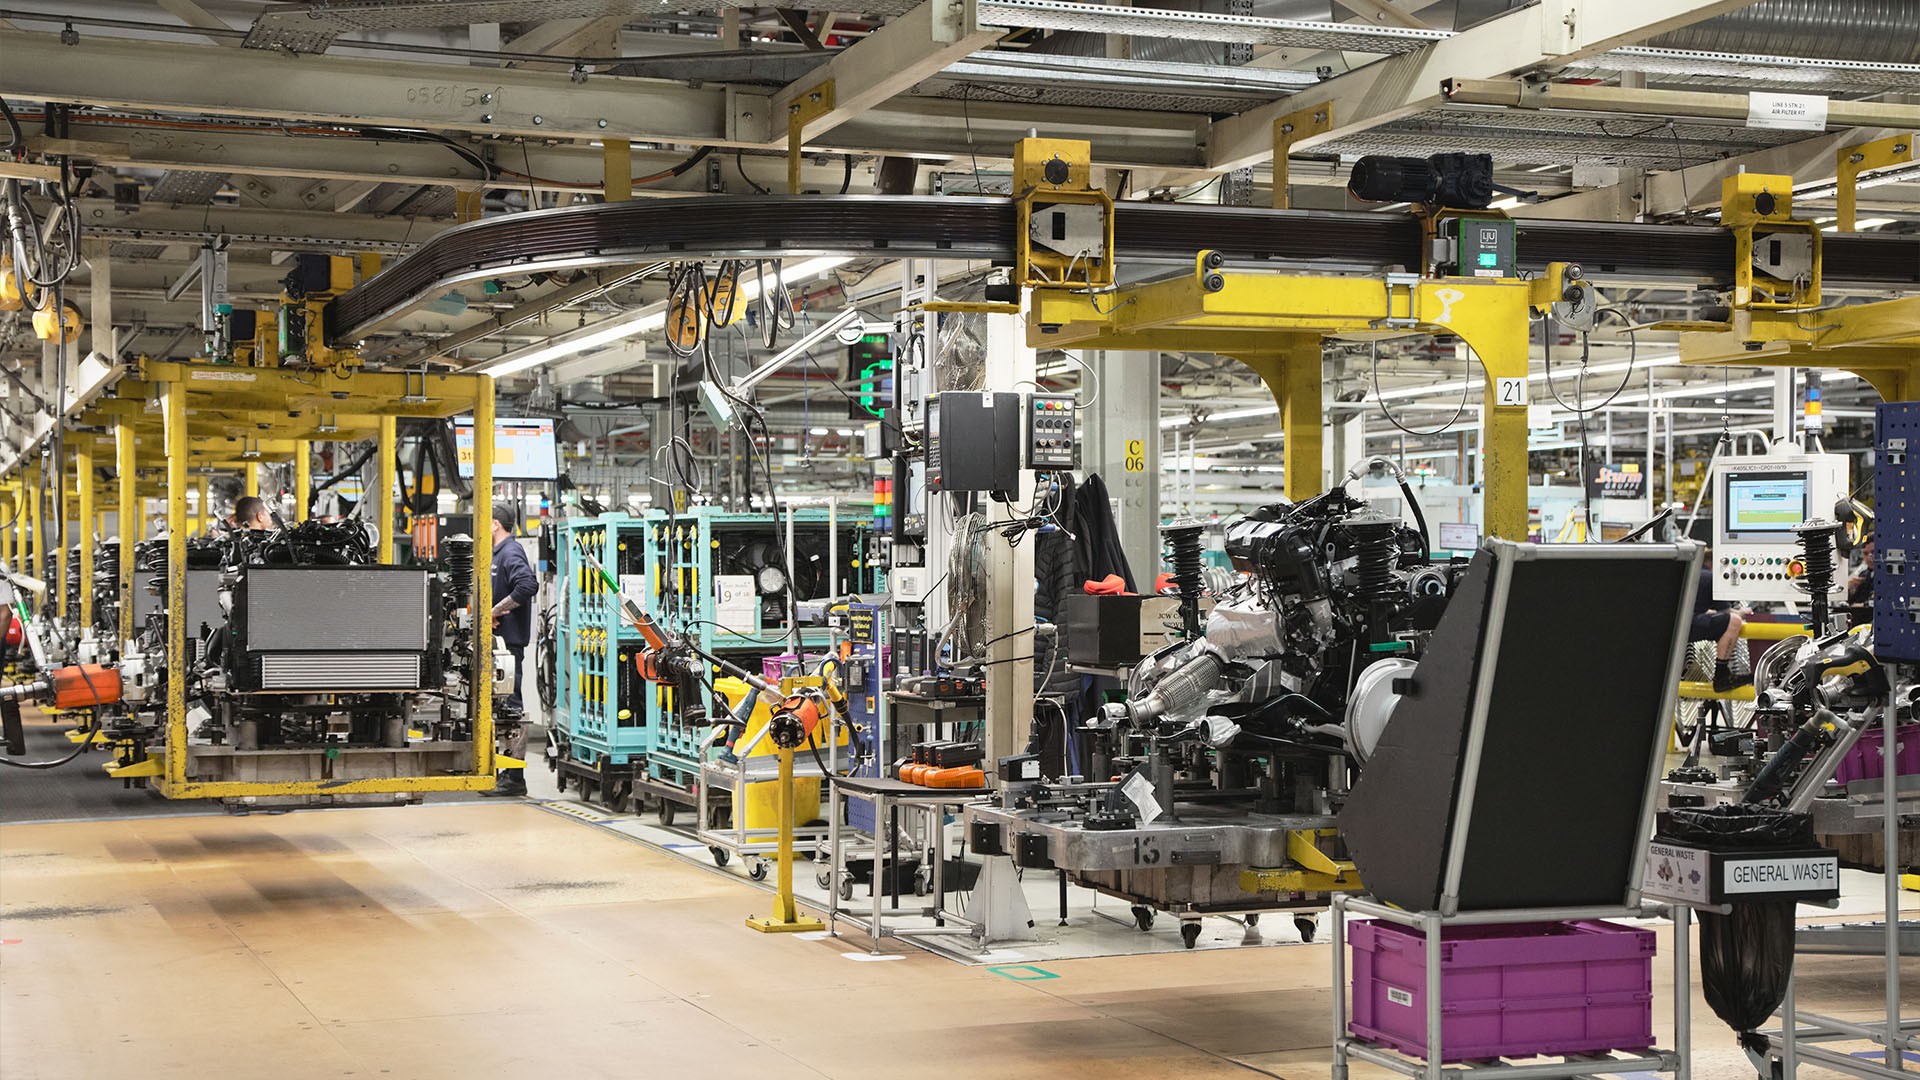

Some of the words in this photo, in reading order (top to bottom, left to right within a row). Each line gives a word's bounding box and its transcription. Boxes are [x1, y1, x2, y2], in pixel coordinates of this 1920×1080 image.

[1482, 231, 1496, 242] LJU
[1503, 381, 1521, 401] 21
[1129, 440, 1140, 455] C
[1125, 456, 1144, 472] 06
[1594, 467, 1643, 483] Sturm
[724, 590, 732, 603] 9
[1133, 836, 1161, 864] 13
[1650, 845, 1676, 858] GENERAL
[1675, 849, 1695, 861] WASTE
[1733, 864, 1789, 884] GENERAL
[1792, 862, 1833, 881] WASTE
